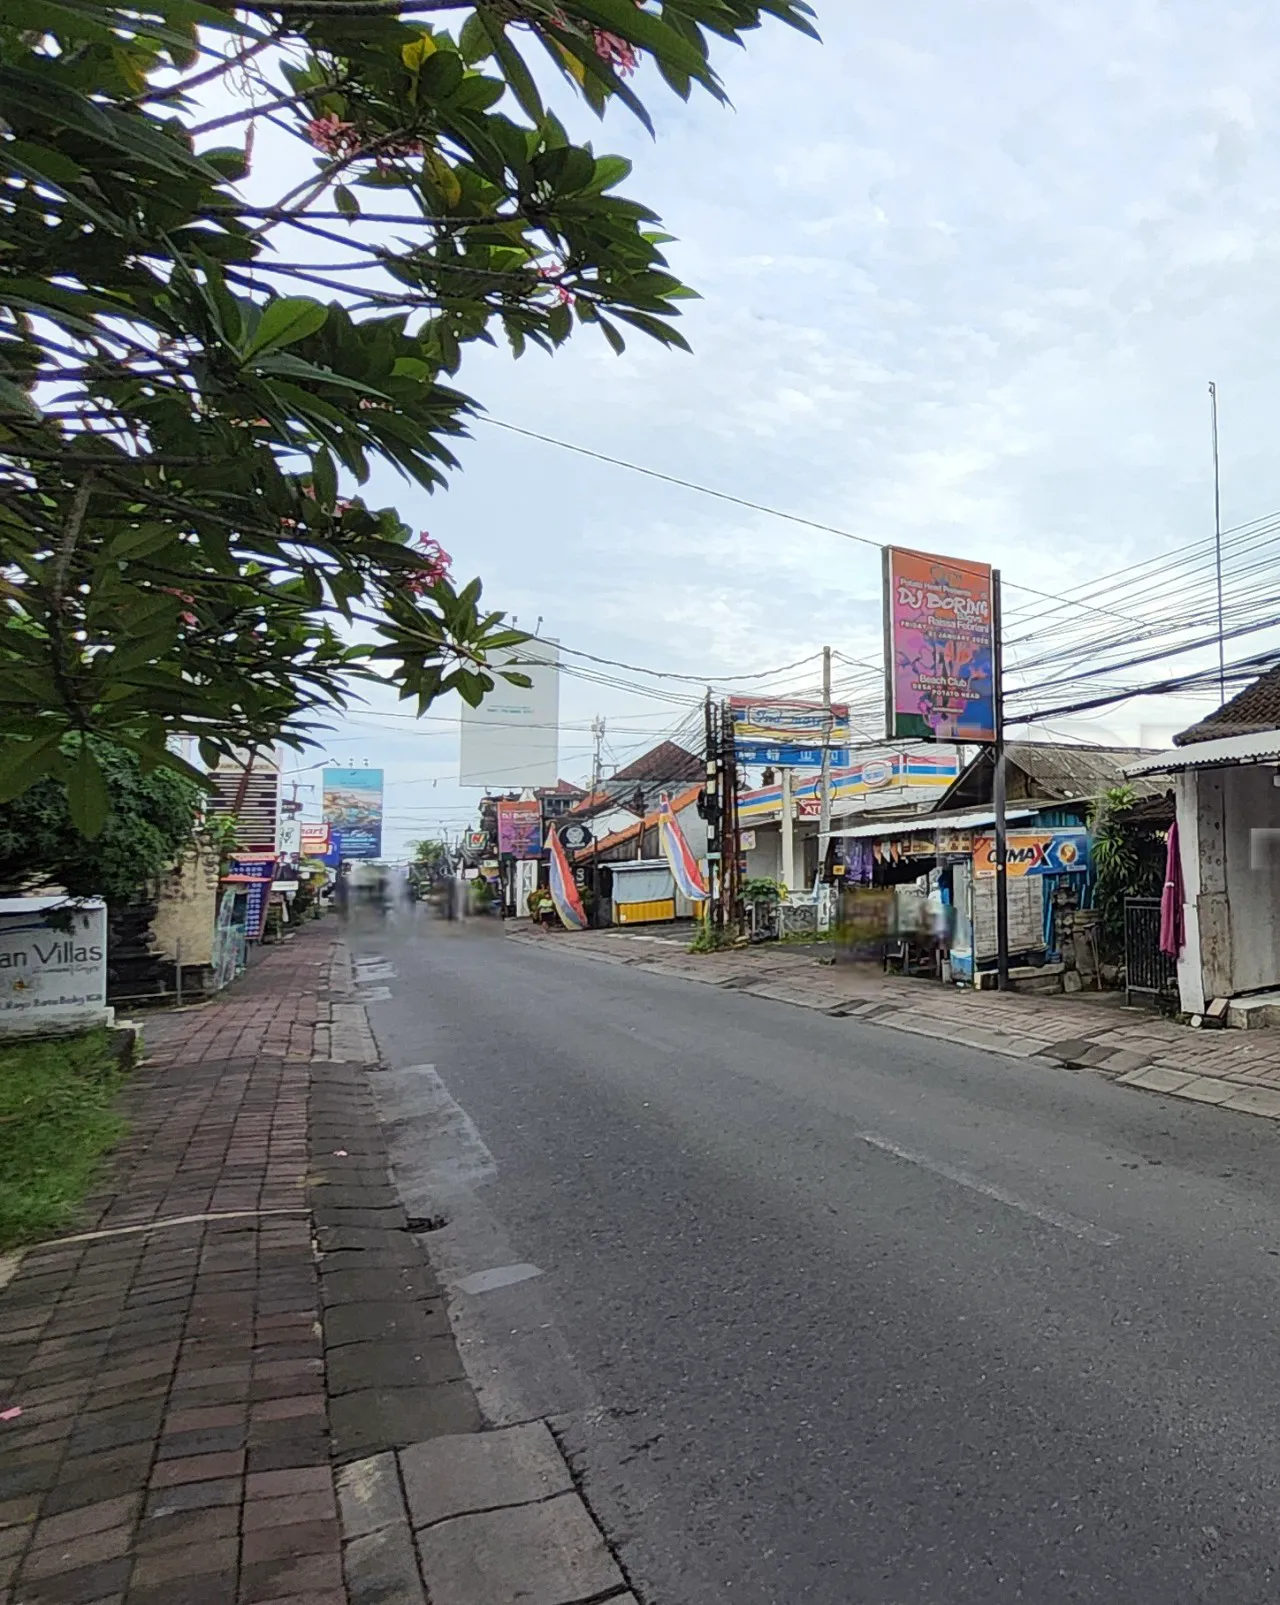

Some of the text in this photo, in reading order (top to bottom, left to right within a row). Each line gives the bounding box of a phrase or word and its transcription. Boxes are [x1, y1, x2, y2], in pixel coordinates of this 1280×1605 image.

[898, 586, 923, 608] DJ
[920, 674, 967, 687] Beach Club
[932, 689, 980, 700] POTATO HEAD
[32, 941, 103, 964] Villas
